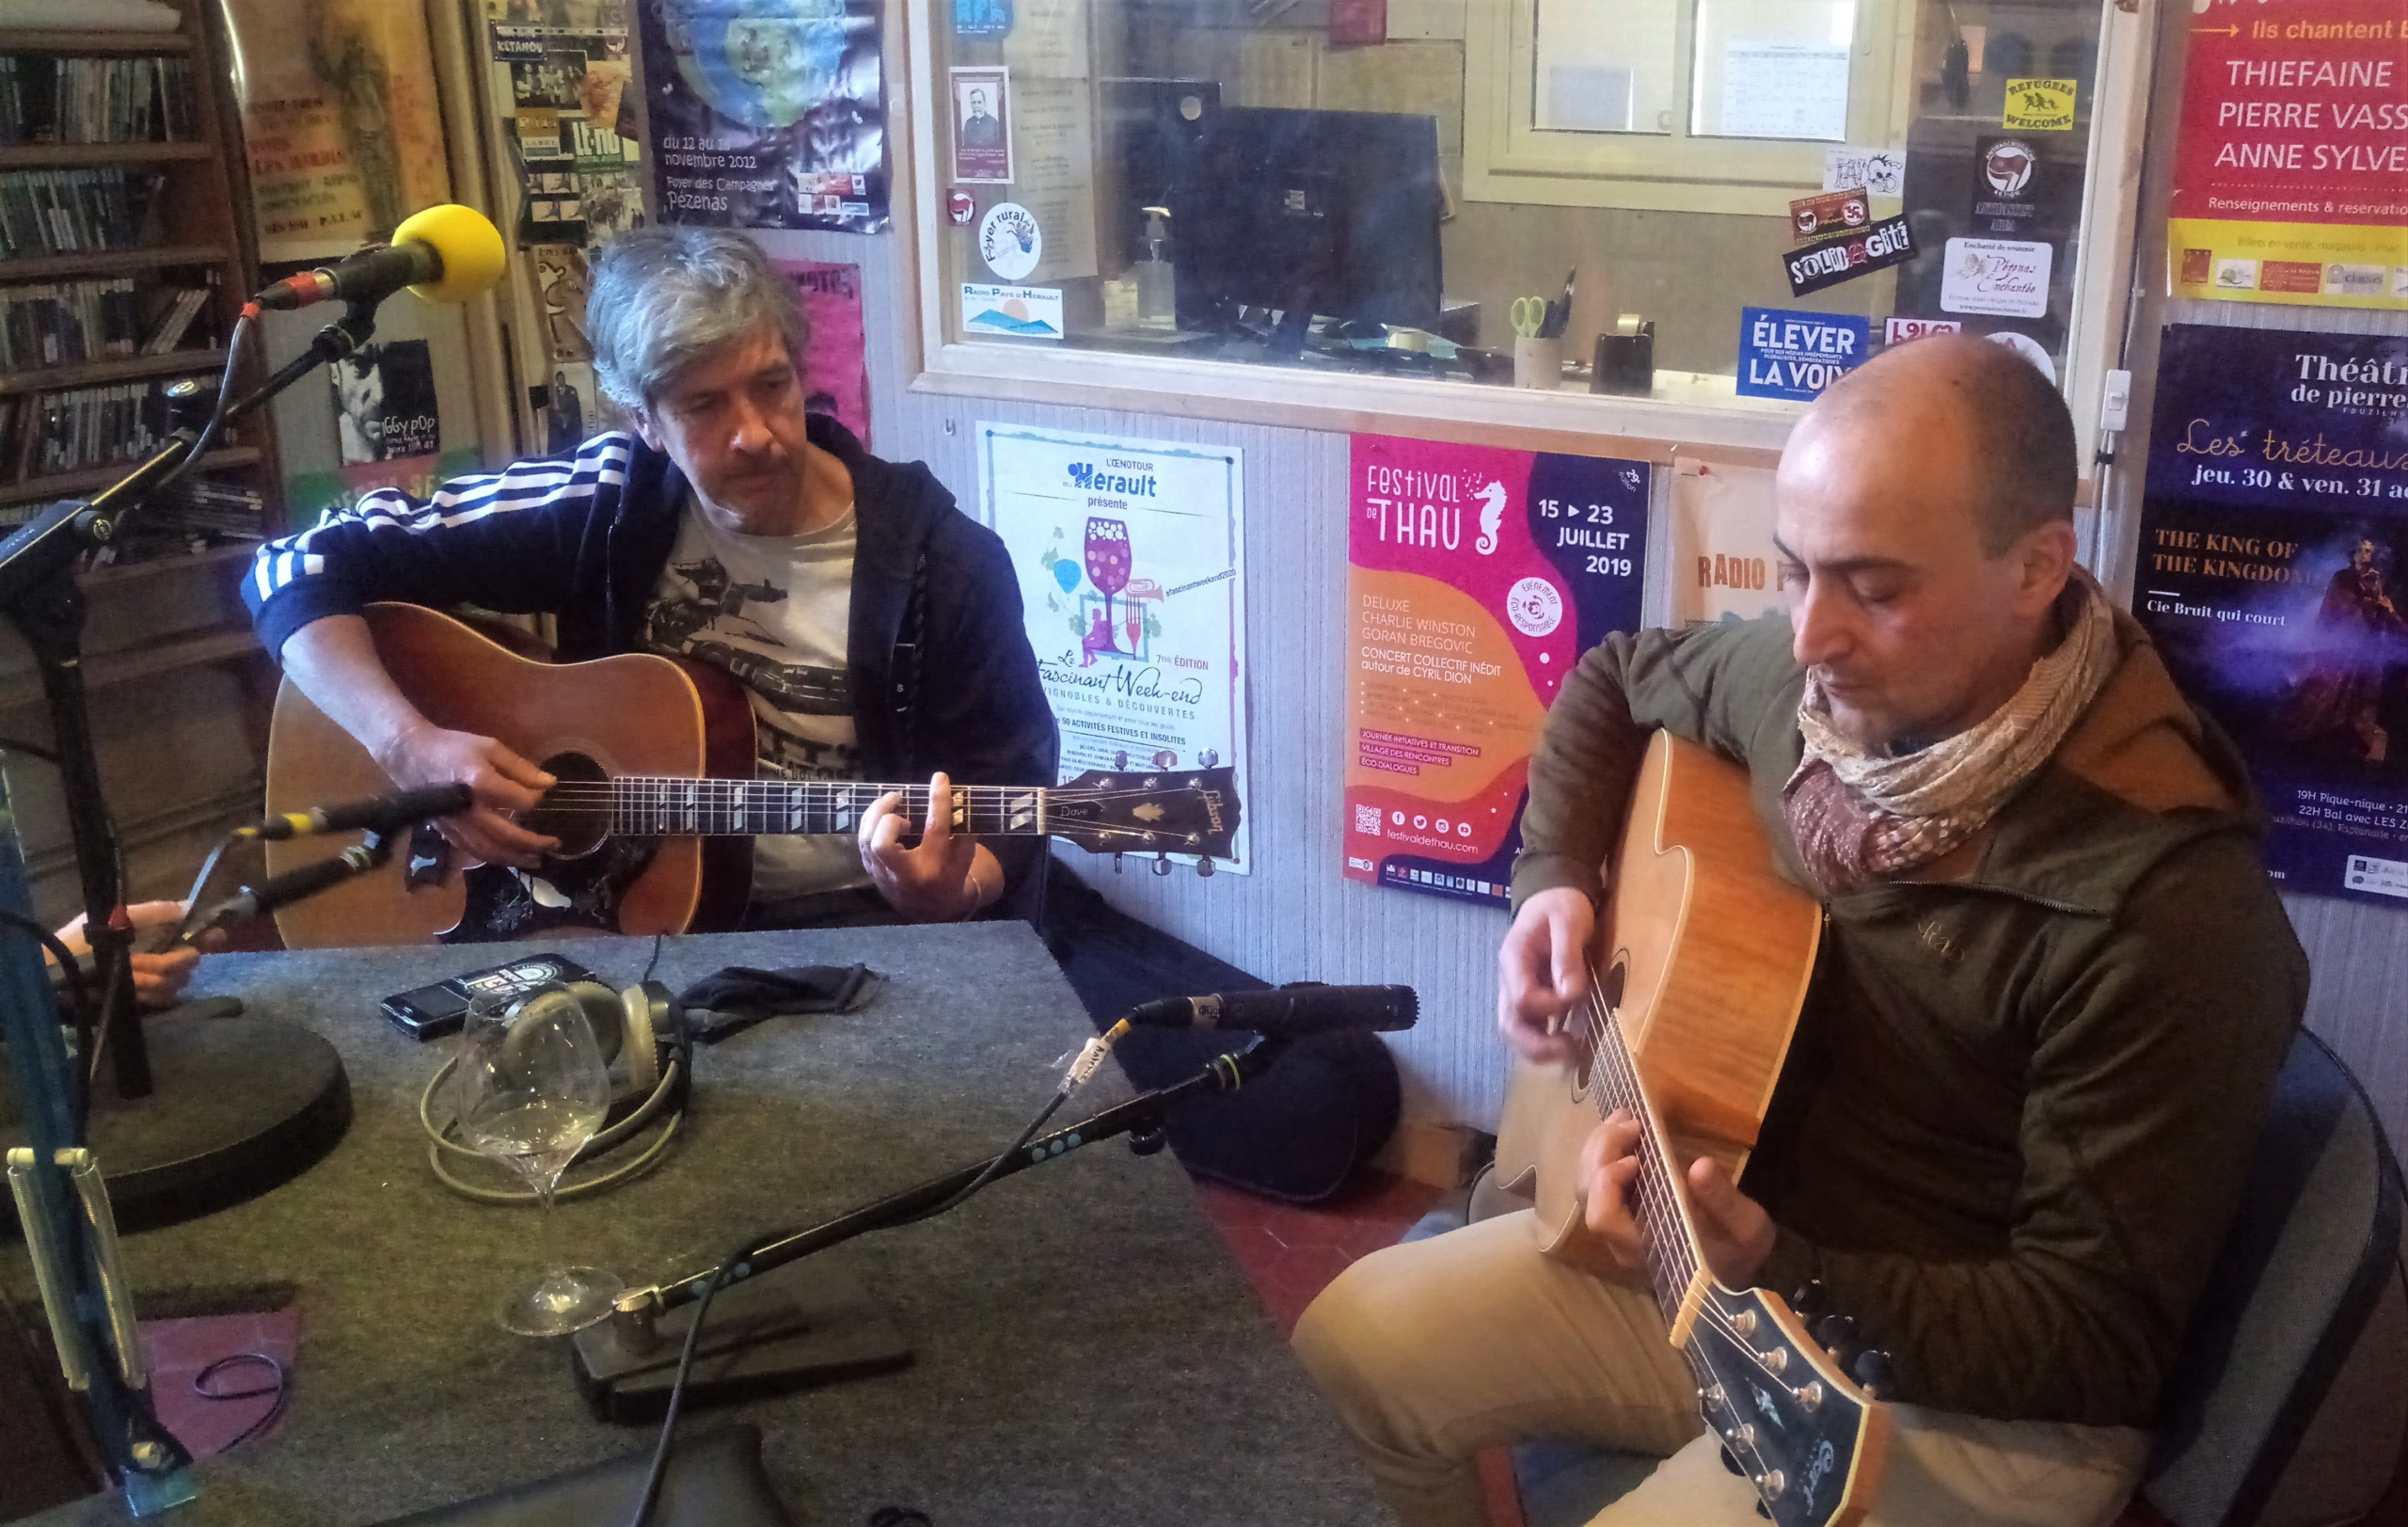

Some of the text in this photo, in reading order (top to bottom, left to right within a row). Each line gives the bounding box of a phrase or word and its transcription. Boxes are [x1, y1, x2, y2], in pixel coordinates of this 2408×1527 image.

[2252, 20, 2393, 39] Ils chantent
[2226, 60, 2394, 87] THIEFAINE
[2008, 80, 2075, 96] REFUGEES
[2006, 114, 2071, 128] WELCOME
[2218, 102, 2408, 130] PIERRE VASS
[663, 136, 679, 150] du
[682, 136, 695, 151] 12
[698, 137, 714, 151] au
[664, 152, 757, 168] novembre 2012
[2214, 143, 2408, 172] ANNE SYLVE
[667, 176, 692, 189] Foyer
[695, 177, 713, 189] des
[667, 191, 728, 211] Pézenas
[2209, 198, 2319, 214] Renseignements
[2323, 200, 2334, 214] &
[997, 211, 1025, 224] rural
[1964, 242, 1995, 250] Enchanté
[1753, 314, 1855, 355] ÉLEVER
[1750, 358, 1783, 386] LA
[2295, 354, 2408, 386] Théâtr
[2291, 384, 2408, 409] de pierre
[2177, 419, 2245, 456] Les
[1070, 462, 1157, 498] Hérault
[2191, 464, 2235, 485] jeu.
[2242, 469, 2272, 488] 30
[2277, 471, 2294, 490] &
[2301, 478, 2350, 495] ven.
[2356, 477, 2381, 497] 31
[1087, 496, 1129, 511] présente
[1539, 499, 1613, 525] 15 23
[1368, 498, 1461, 550] THAU
[1556, 526, 1629, 551] JUILLET
[2155, 528, 2299, 559] THE KING OF
[1586, 555, 1632, 577] 2019
[1698, 553, 1766, 591] RADIO
[2152, 553, 2197, 574] THE
[1363, 595, 1410, 612] DELUXE
[2147, 599, 2287, 627] Cie Bruit qui court
[1362, 611, 1476, 638] CHARLIE WINSTON
[1362, 628, 1473, 654] GORAN BREGOVIC
[1058, 649, 1075, 668] Le
[1174, 657, 1209, 671] ÉDITION
[1362, 646, 1501, 676] CONCERT COLLECTIF INÉDIT
[1117, 663, 1203, 705] Week-end
[1361, 660, 1472, 685] autour de CYRIL DION
[1105, 697, 1112, 707] &
[1117, 699, 1196, 720] DÉCOUVERTES
[1062, 717, 1070, 726] 50
[1072, 719, 1106, 731] ACTIVITÉS
[1107, 725, 1138, 738] FESTIVES
[1140, 730, 1149, 740] ET
[1150, 732, 1186, 745] INSOLITES
[1362, 730, 1479, 756] JOURNÉE INITIATIVES ET TRANSITION
[1361, 757, 1418, 774] ÉCO-DIALOGUES
[1362, 745, 1450, 766] VILLAGE DES RENCONTRES
[1060, 805, 1089, 818] Dove
[2297, 789, 2317, 801] 19H
[2320, 792, 2385, 813] Pique-nique
[2299, 804, 2321, 817] 22H
[2323, 808, 2342, 819] Bal
[2345, 813, 2371, 824] avec
[2374, 816, 2396, 828] LES
[1386, 829, 1479, 854] festivaldethau.com
